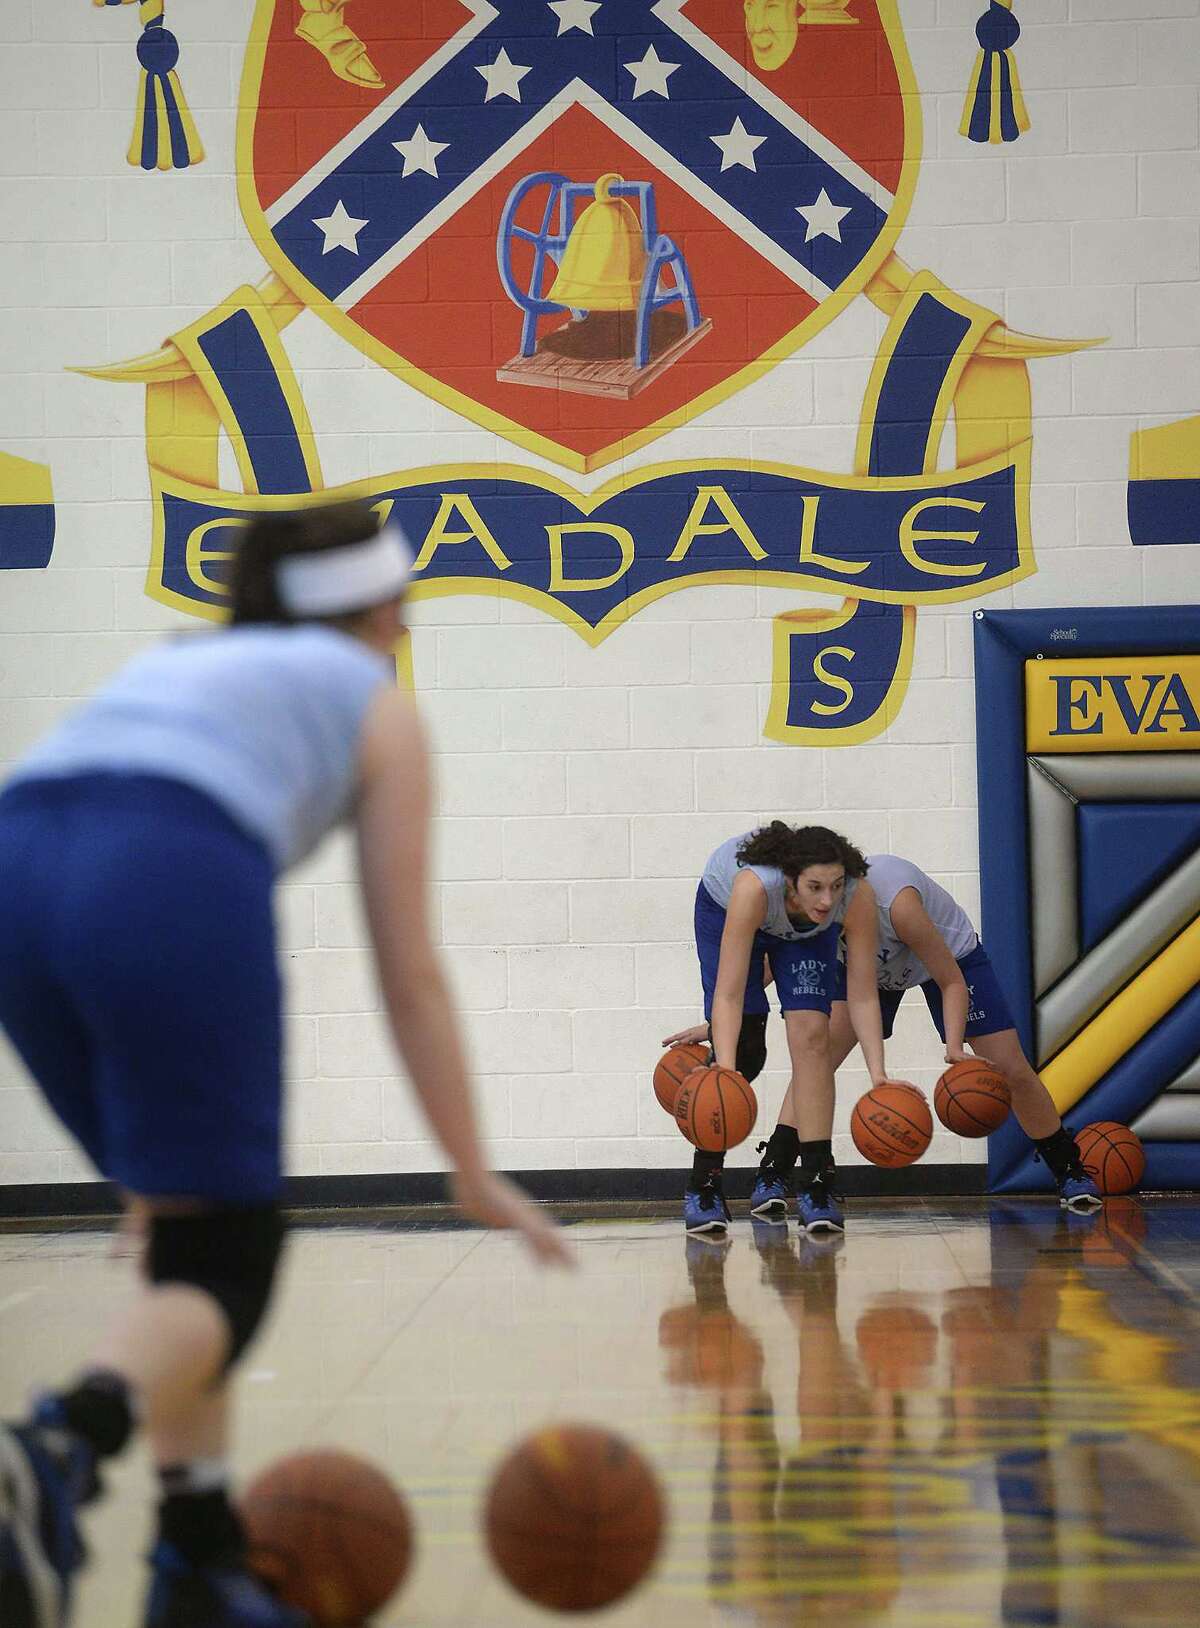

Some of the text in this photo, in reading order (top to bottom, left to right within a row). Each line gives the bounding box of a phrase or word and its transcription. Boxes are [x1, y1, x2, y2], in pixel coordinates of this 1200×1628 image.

[186, 485, 987, 595] EADALE
[810, 646, 856, 715] S
[1048, 673, 1200, 736] EVA
[791, 959, 827, 974] LADY
[792, 986, 826, 996] REBELS
